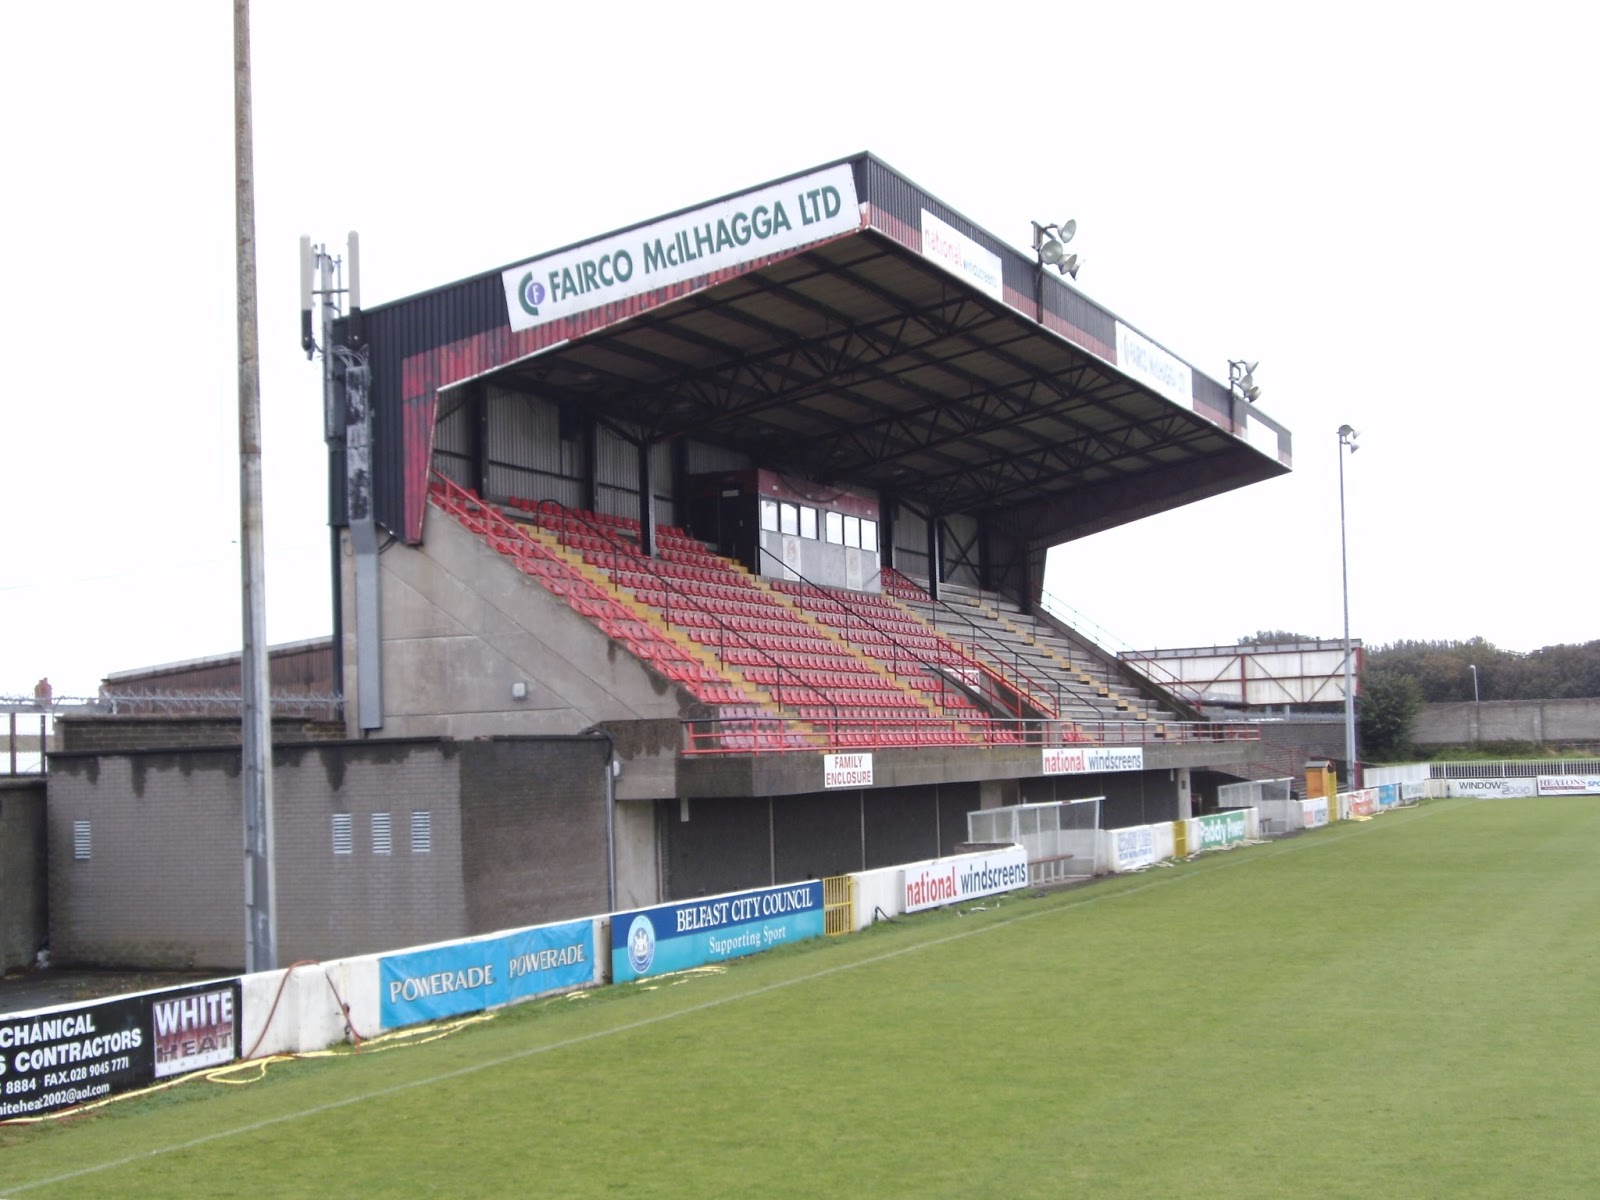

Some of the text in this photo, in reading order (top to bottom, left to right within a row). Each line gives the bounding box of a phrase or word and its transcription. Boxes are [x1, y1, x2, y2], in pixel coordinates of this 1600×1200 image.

[548, 184, 841, 303] FAIRCO McILHAGGA LTD
[826, 770, 871, 785] ENCLOSURE
[834, 755, 863, 769] FAMILY
[1044, 750, 1141, 772] national windscreens
[1459, 781, 1508, 790] WINDOWS
[1198, 818, 1226, 844] Paddy
[906, 860, 1026, 907] national windscreens
[676, 887, 812, 932] BELFAST CITY COUNCIL
[709, 925, 787, 955] Supporting Sport
[509, 944, 585, 979] POWERADE
[389, 965, 493, 1004] POWERADE
[0, 1013, 96, 1049] CHANICAL
[155, 991, 233, 1038] WHITE
[14, 1027, 143, 1073] CONTRACTORS
[156, 1032, 232, 1064] HEAT
[5, 1077, 37, 1095] 8884
[89, 1061, 110, 1078] 9045
[111, 1056, 130, 1072] 7771
